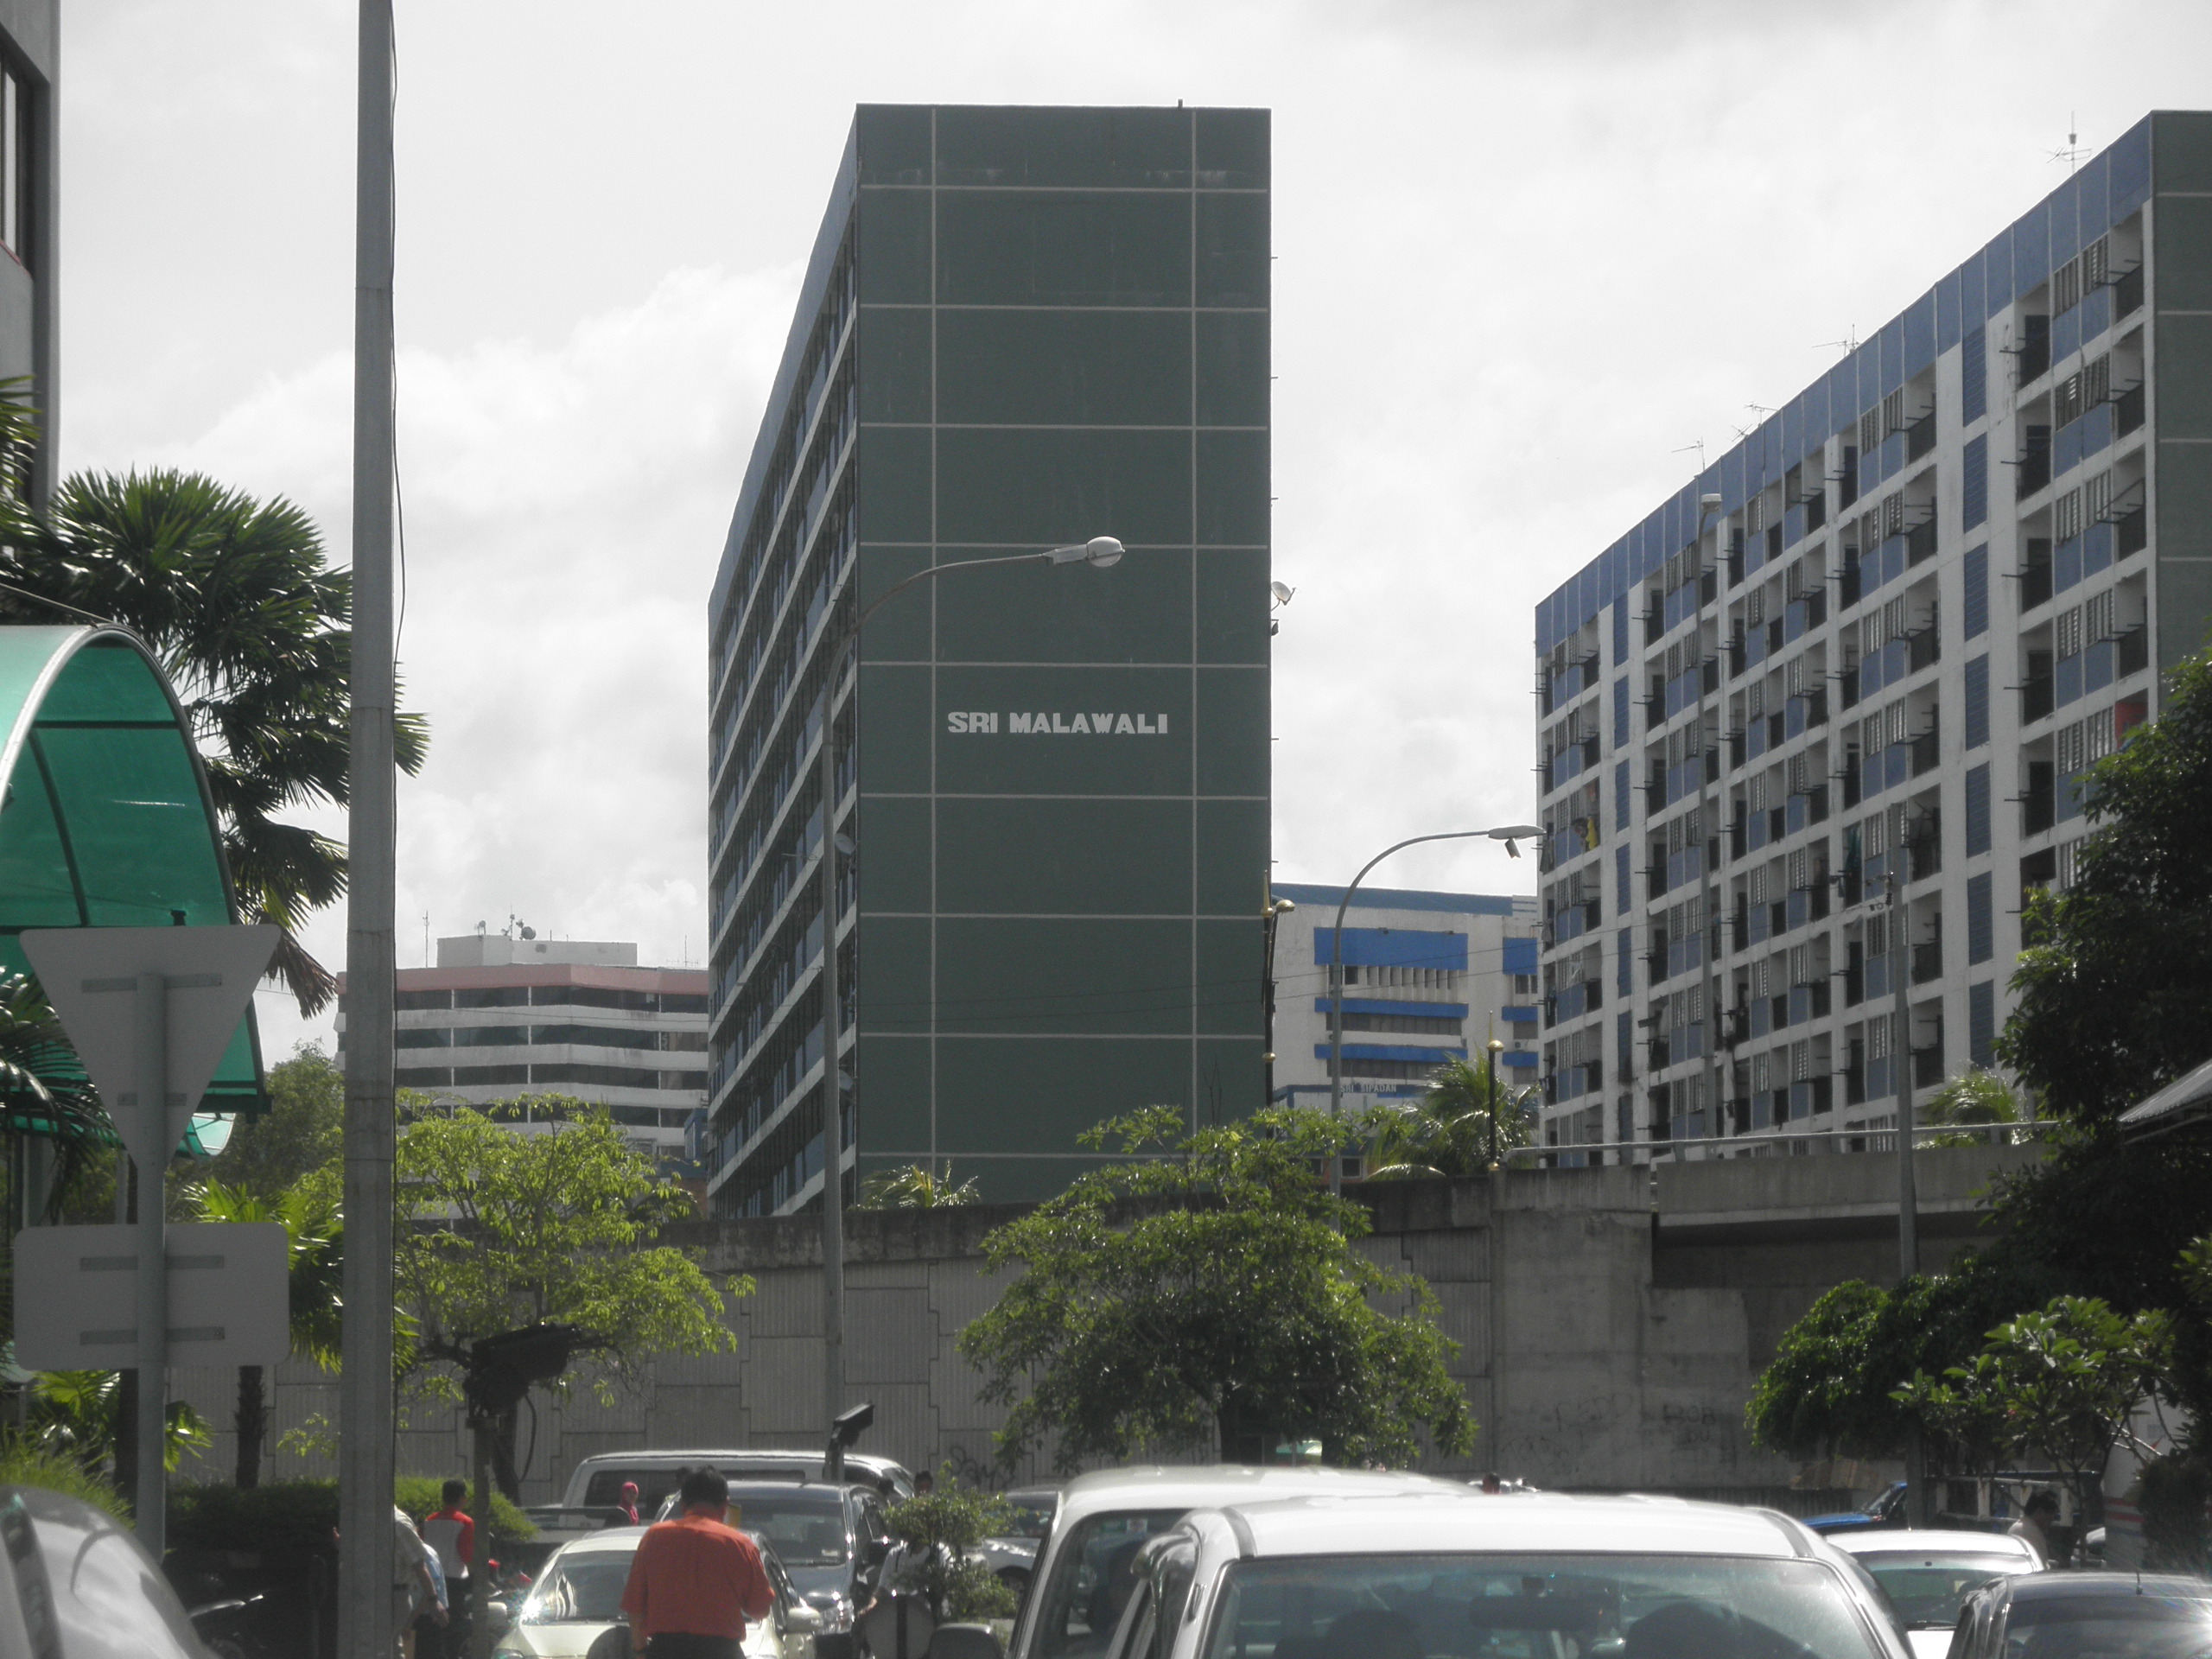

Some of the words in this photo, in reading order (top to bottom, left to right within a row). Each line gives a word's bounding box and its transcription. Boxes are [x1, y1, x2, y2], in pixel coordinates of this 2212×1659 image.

[948, 712, 998, 734] SRI
[1009, 712, 1168, 734] MALAWALI
[1340, 1084, 1354, 1093] SRI
[1360, 1084, 1397, 1093] SIPADAN
